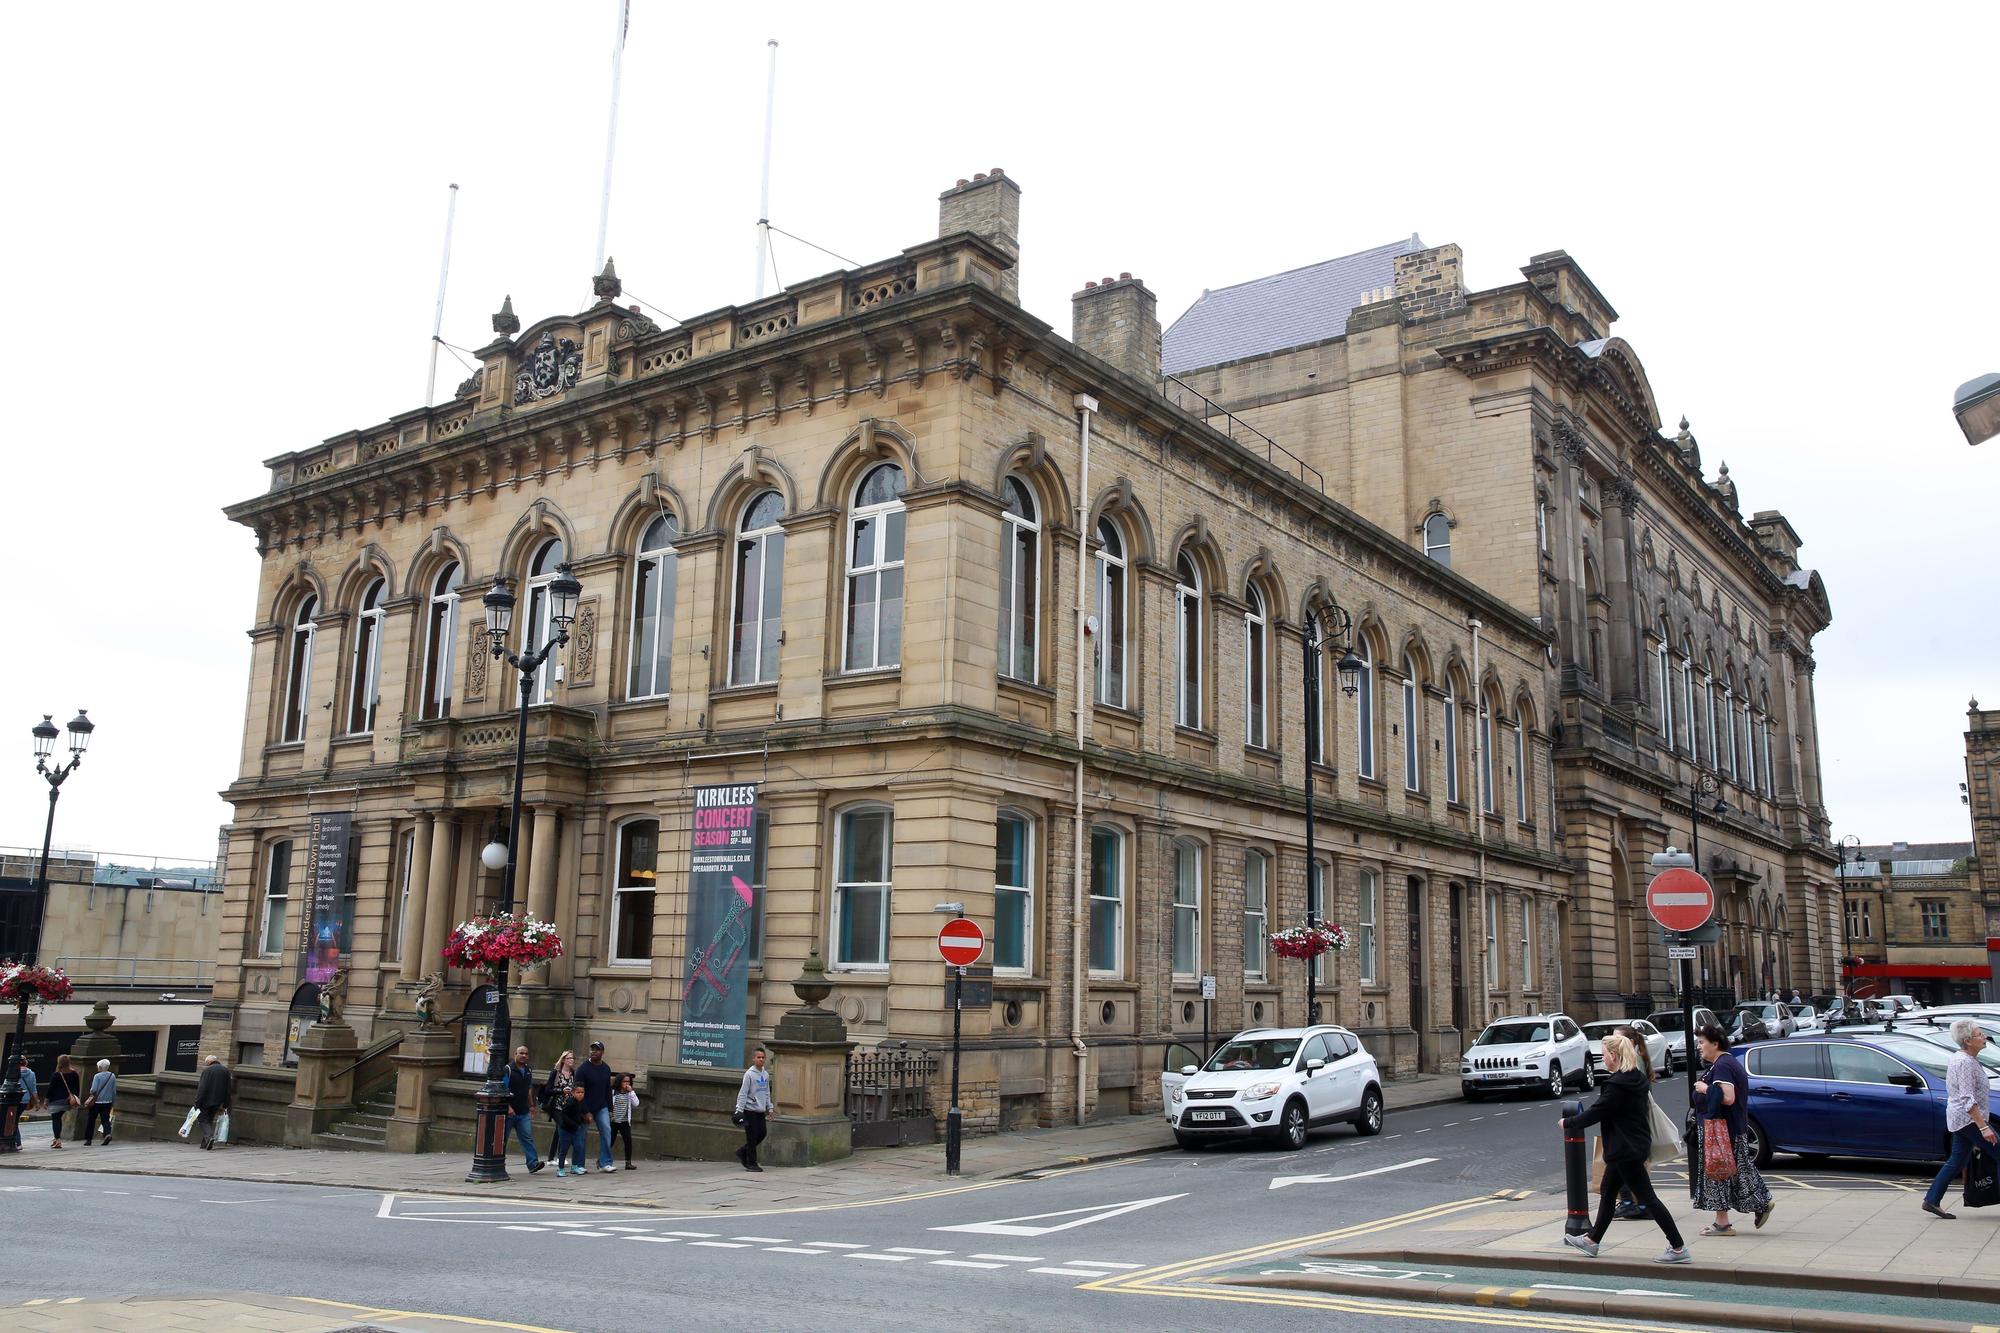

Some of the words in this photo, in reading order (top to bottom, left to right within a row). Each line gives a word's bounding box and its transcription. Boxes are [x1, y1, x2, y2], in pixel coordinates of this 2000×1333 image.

[696, 786, 755, 807] KIRKLEES
[695, 807, 753, 829] CONCERT
[312, 817, 320, 841] Hall
[694, 830, 730, 846] SEASON
[320, 844, 337, 852] Meetings
[308, 844, 319, 874] Town
[693, 855, 751, 863] KIRKLEESTOWNHALLS.CO.UK
[300, 878, 315, 954] Huddersfield
[682, 1039, 710, 1048] Family-friendly
[1974, 1176, 1993, 1188] M&S
